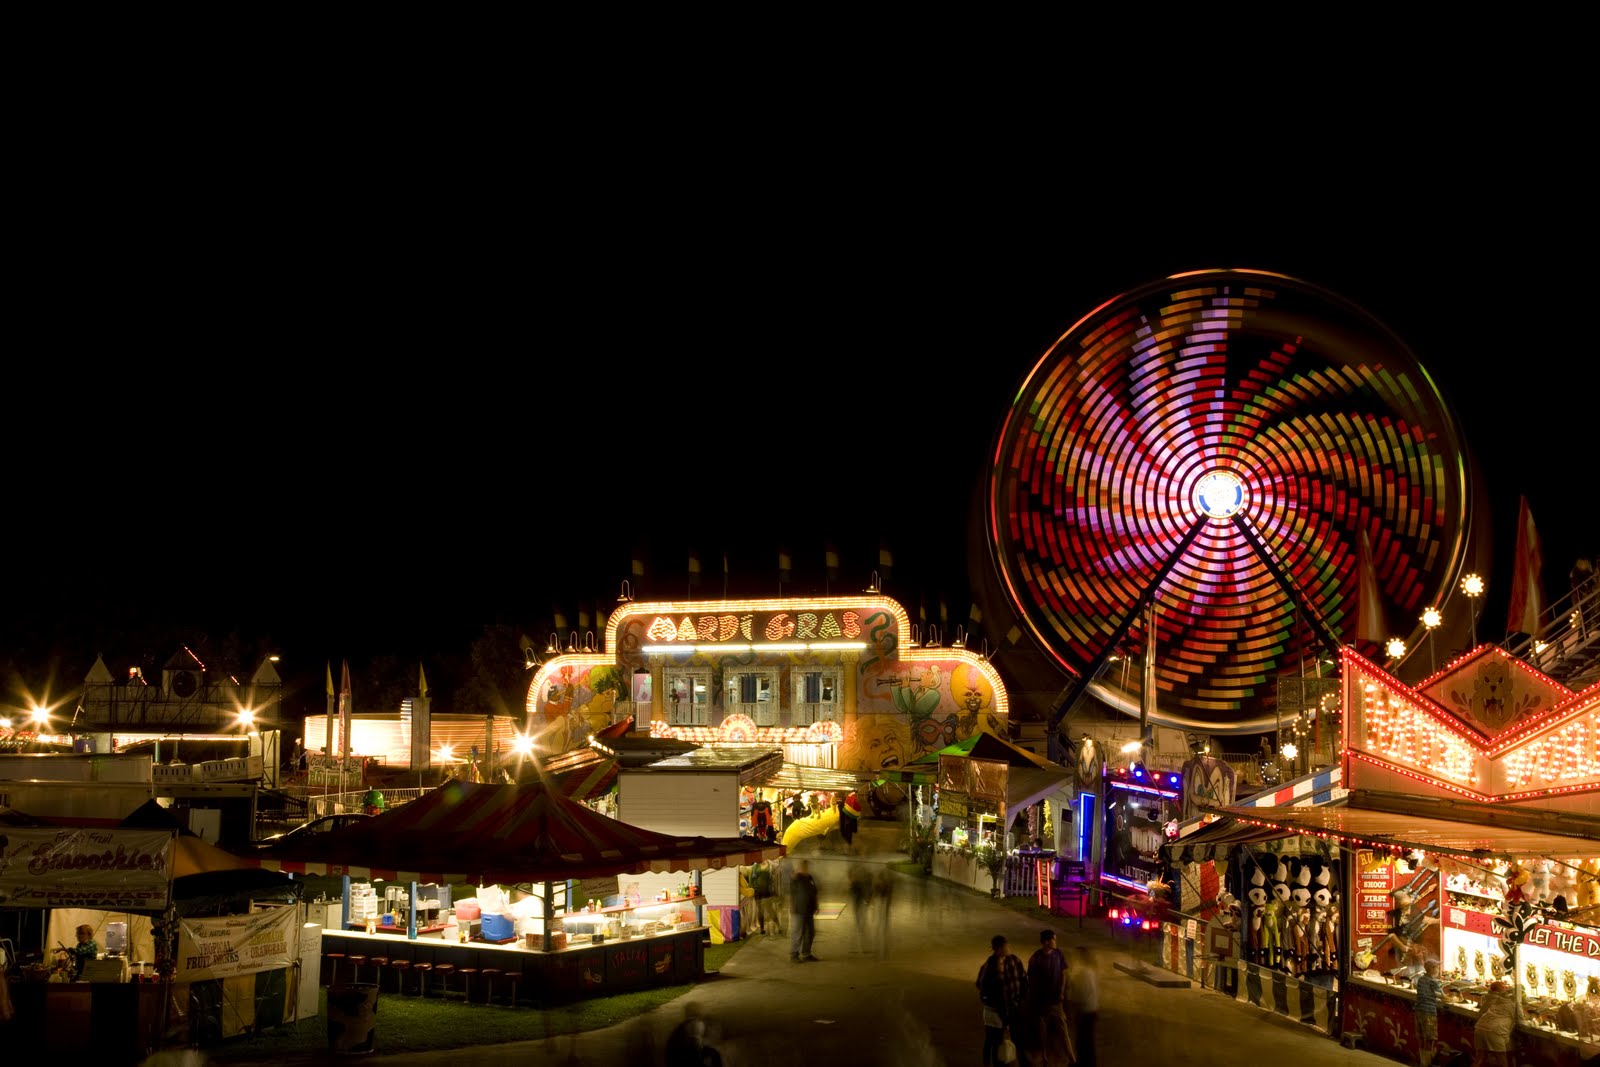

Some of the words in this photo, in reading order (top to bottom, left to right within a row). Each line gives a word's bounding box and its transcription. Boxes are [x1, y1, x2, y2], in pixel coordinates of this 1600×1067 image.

[646, 614, 753, 642] MARDI
[765, 611, 861, 641] GRAS
[89, 832, 114, 844] Fruit
[28, 843, 165, 876] Smoothies
[1125, 864, 1151, 882] ULTIMATE
[1363, 881, 1387, 889] SHOOT
[32, 890, 163, 900] ORANGEADE
[47, 899, 147, 907] LIMEADE
[1363, 894, 1387, 903] FIRST
[209, 929, 232, 937] NATURAL
[1529, 928, 1552, 946] LET
[1554, 932, 1584, 953] THE
[200, 940, 234, 956] TROPICAL
[250, 941, 288, 959] ORANGEADE
[186, 954, 212, 970] FRUIT
